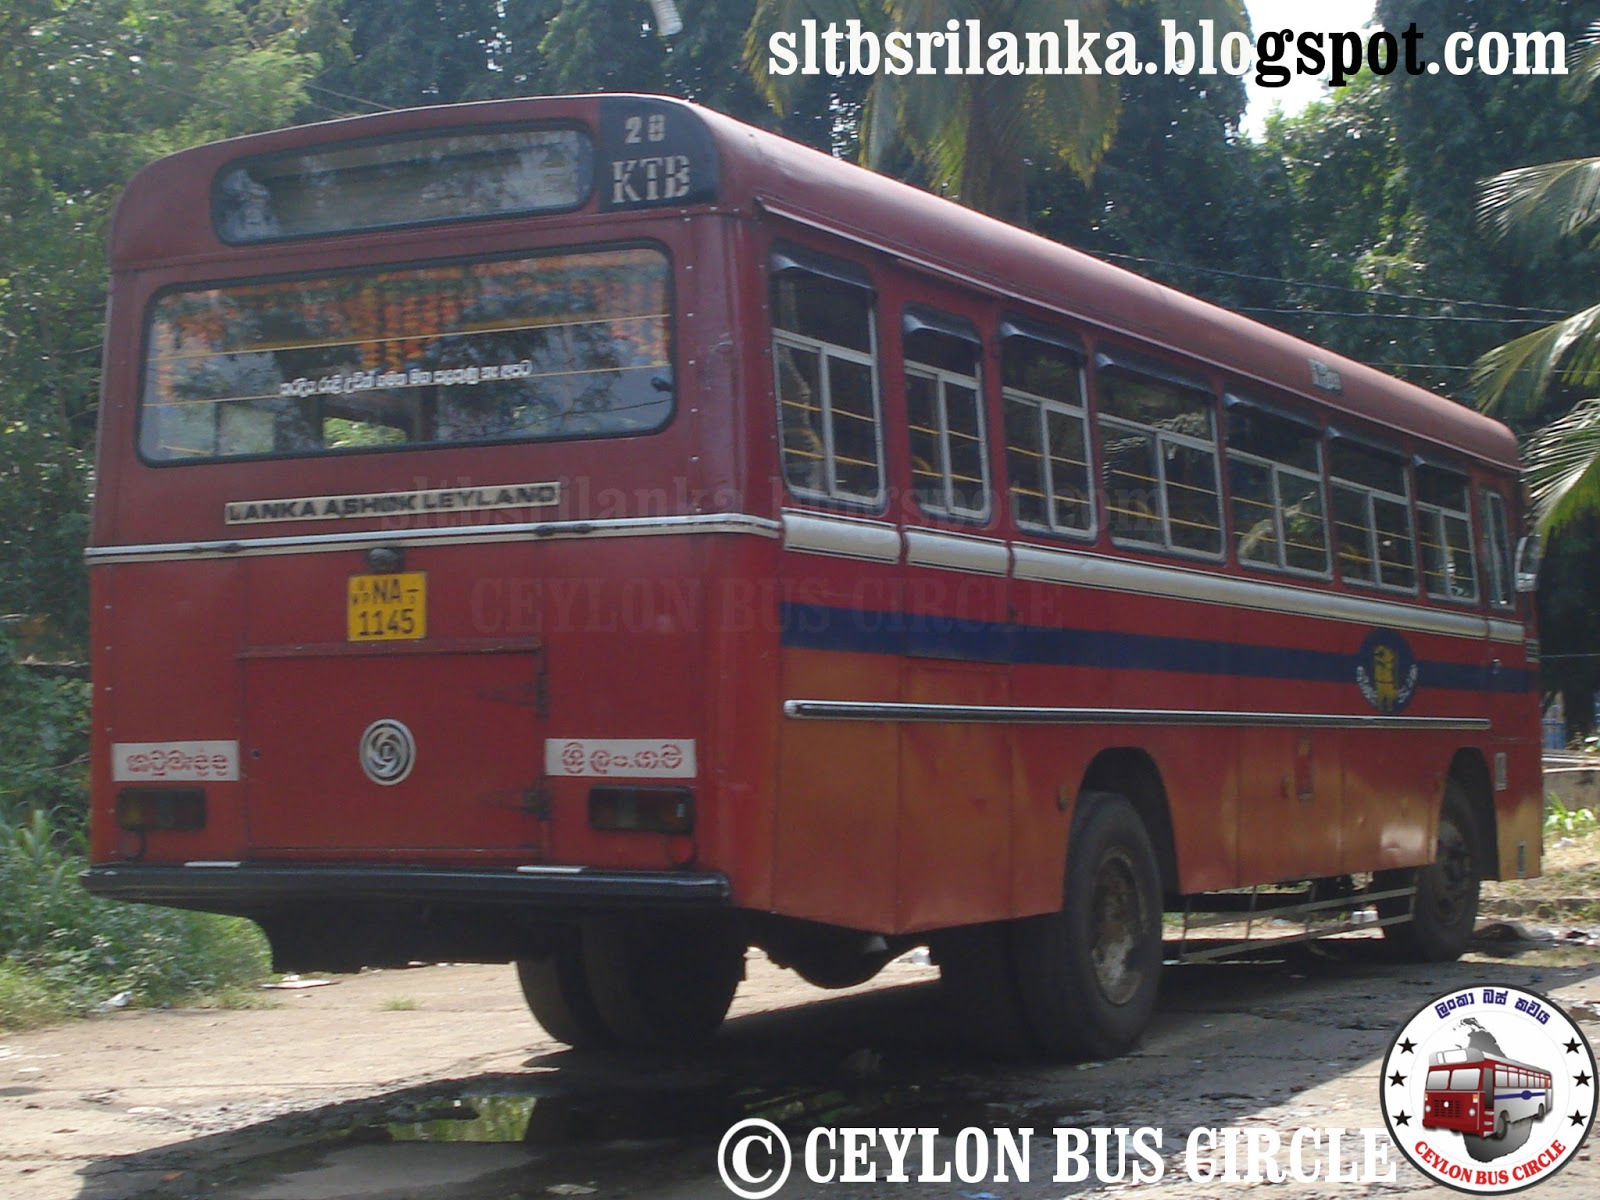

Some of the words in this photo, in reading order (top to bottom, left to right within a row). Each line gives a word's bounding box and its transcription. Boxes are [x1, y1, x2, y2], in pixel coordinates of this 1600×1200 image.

[624, 114, 665, 144] 28
[611, 155, 690, 203] KTB
[227, 501, 317, 522] LANKA
[322, 494, 417, 518] ASHOK
[423, 485, 557, 510] LEYLAND
[358, 608, 415, 636] 1145
